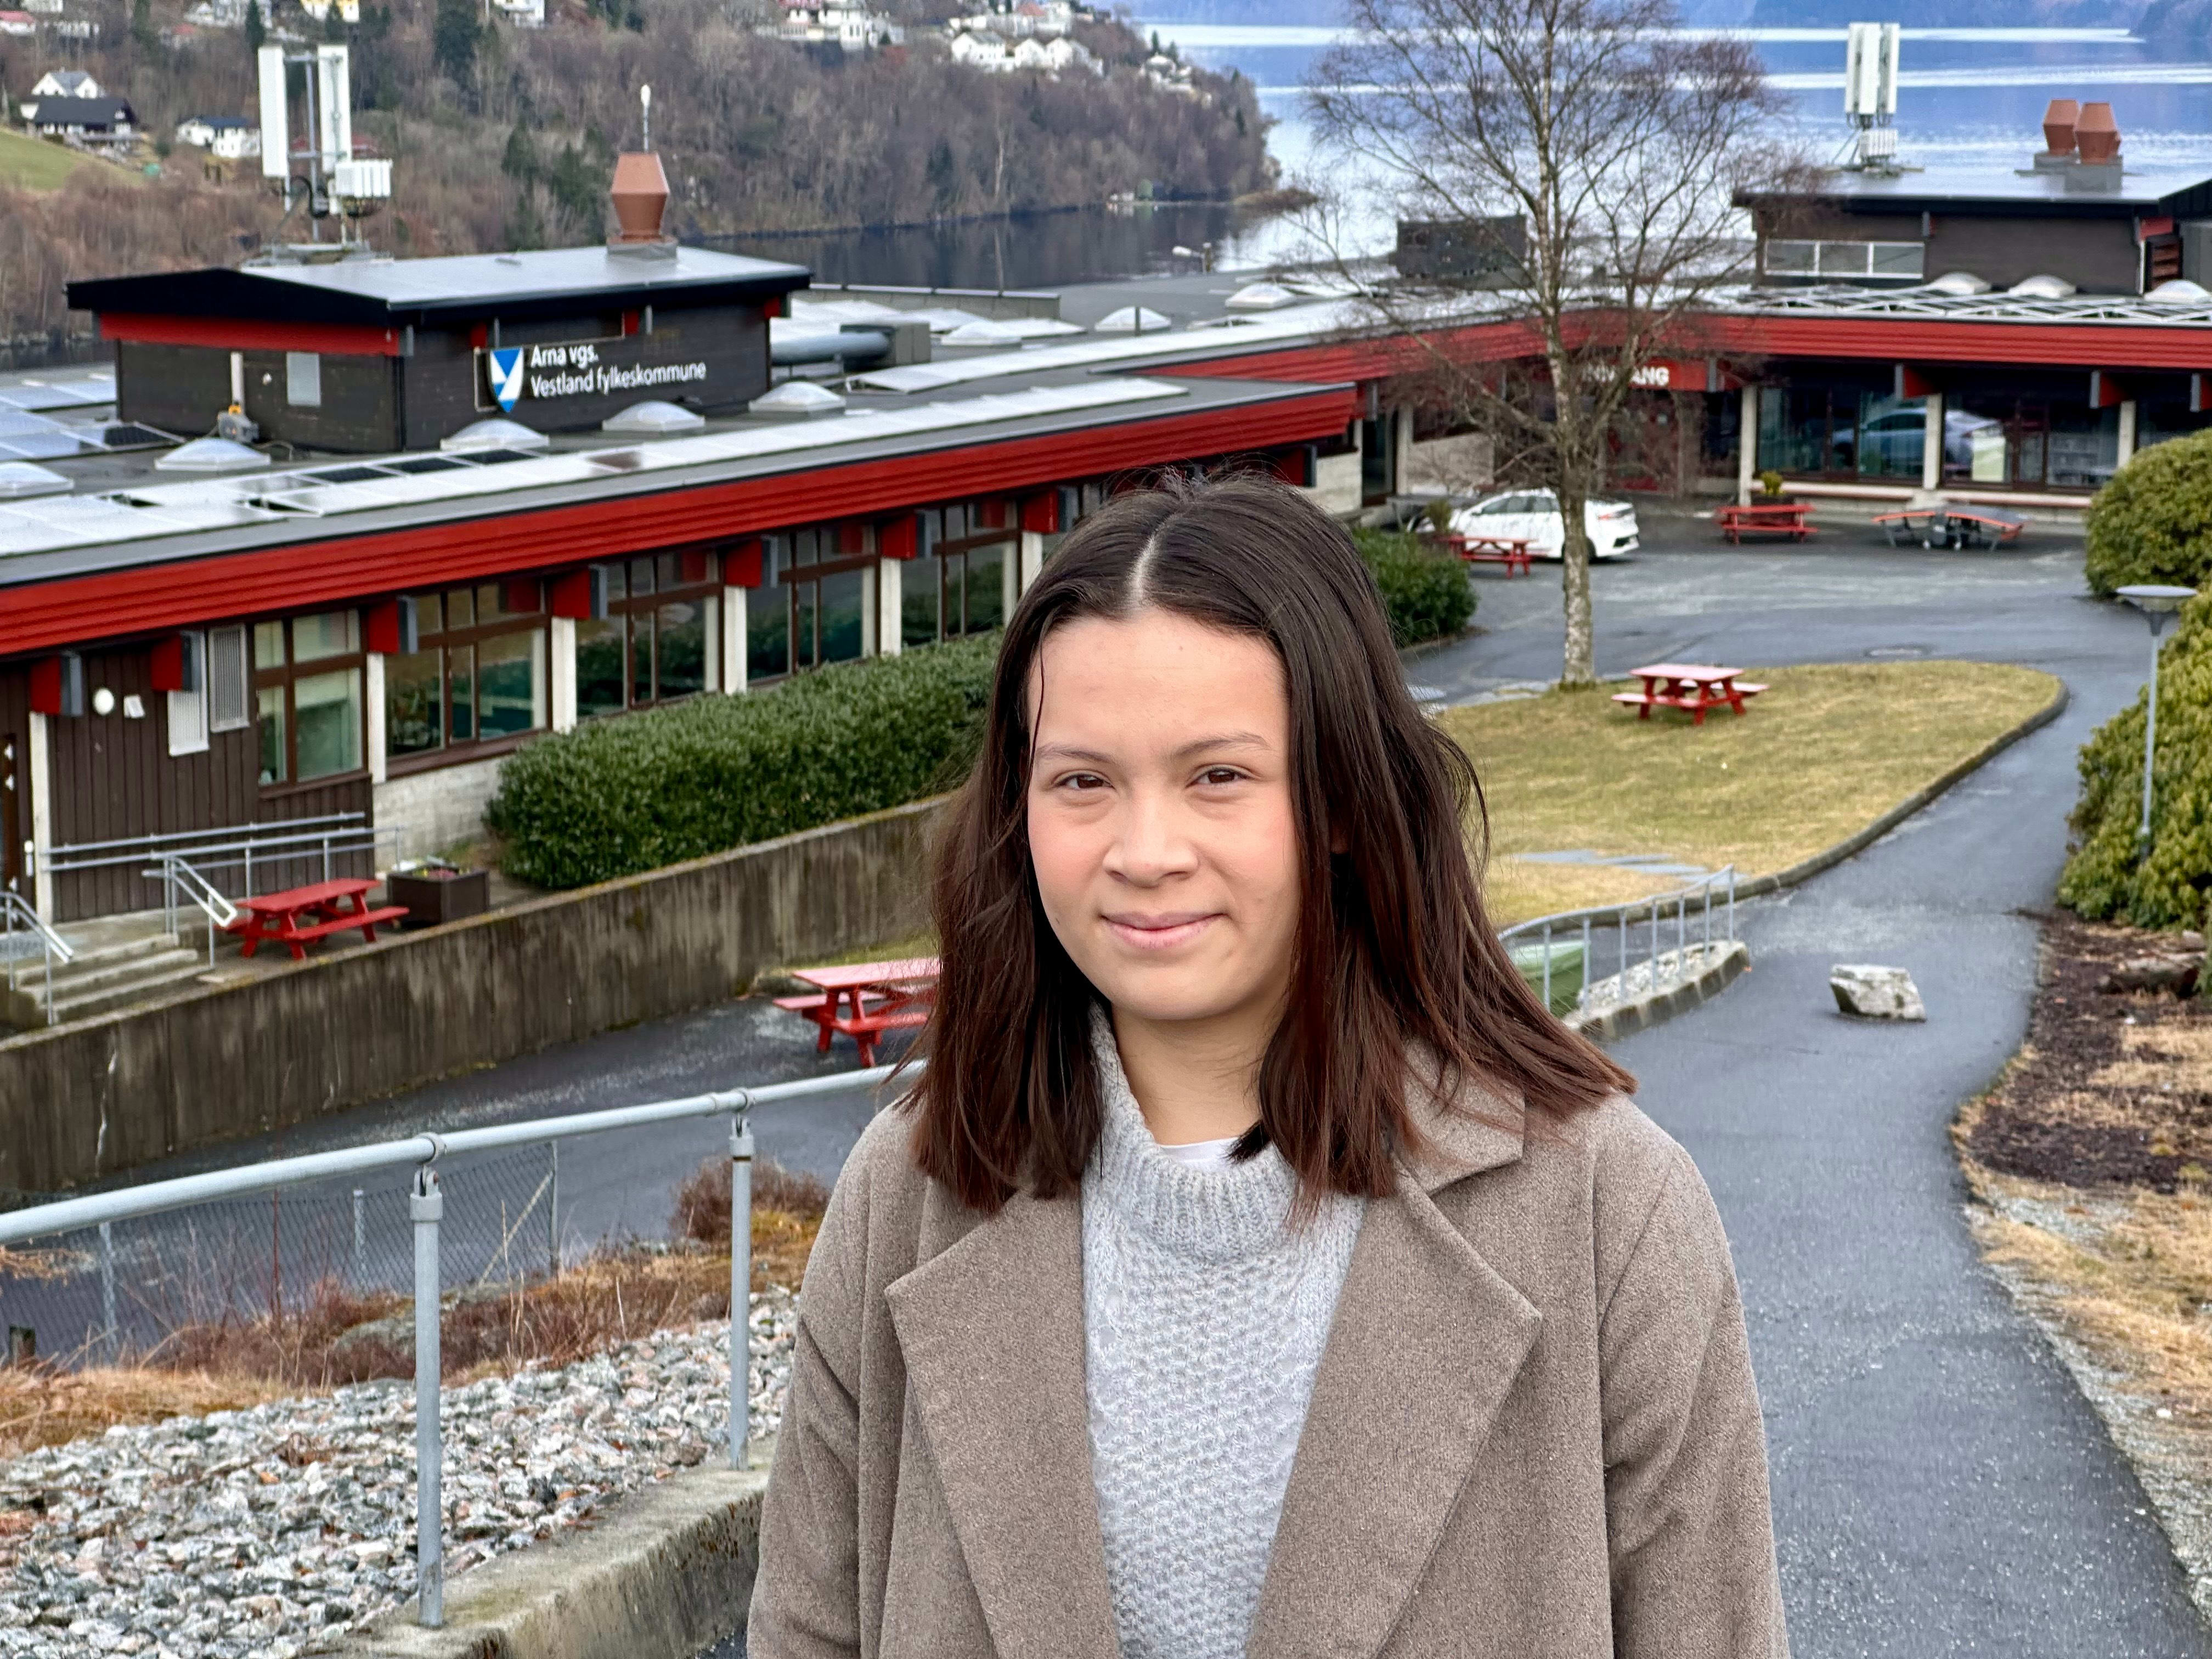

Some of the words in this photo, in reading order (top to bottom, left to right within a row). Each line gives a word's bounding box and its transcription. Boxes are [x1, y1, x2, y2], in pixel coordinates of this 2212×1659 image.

[531, 345, 567, 368] Arna
[569, 345, 599, 369] vgs.
[531, 368, 593, 398] Vestland
[597, 362, 706, 396] fylkeskommune
